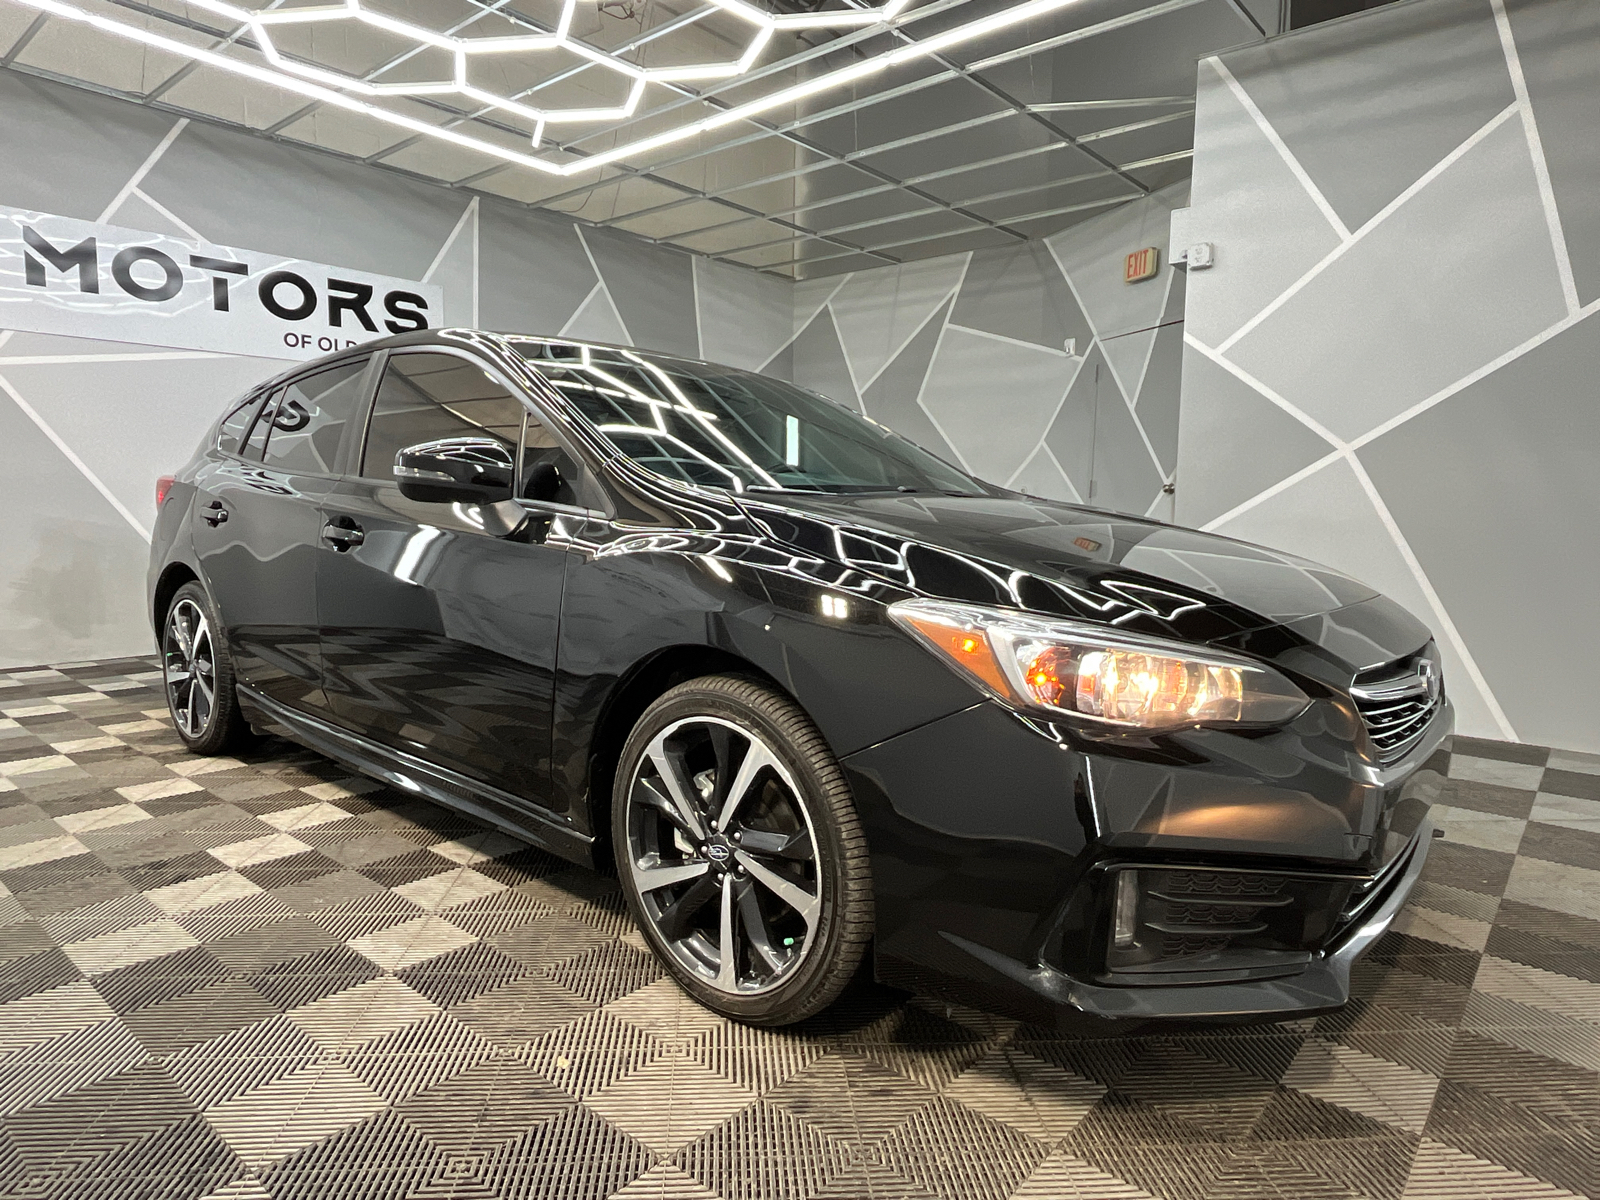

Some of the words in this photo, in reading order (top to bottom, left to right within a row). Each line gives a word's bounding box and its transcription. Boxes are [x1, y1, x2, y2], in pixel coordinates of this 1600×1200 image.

[1127, 249, 1149, 279] EXIT
[22, 225, 429, 334] MOTORS
[283, 332, 312, 349] OF
